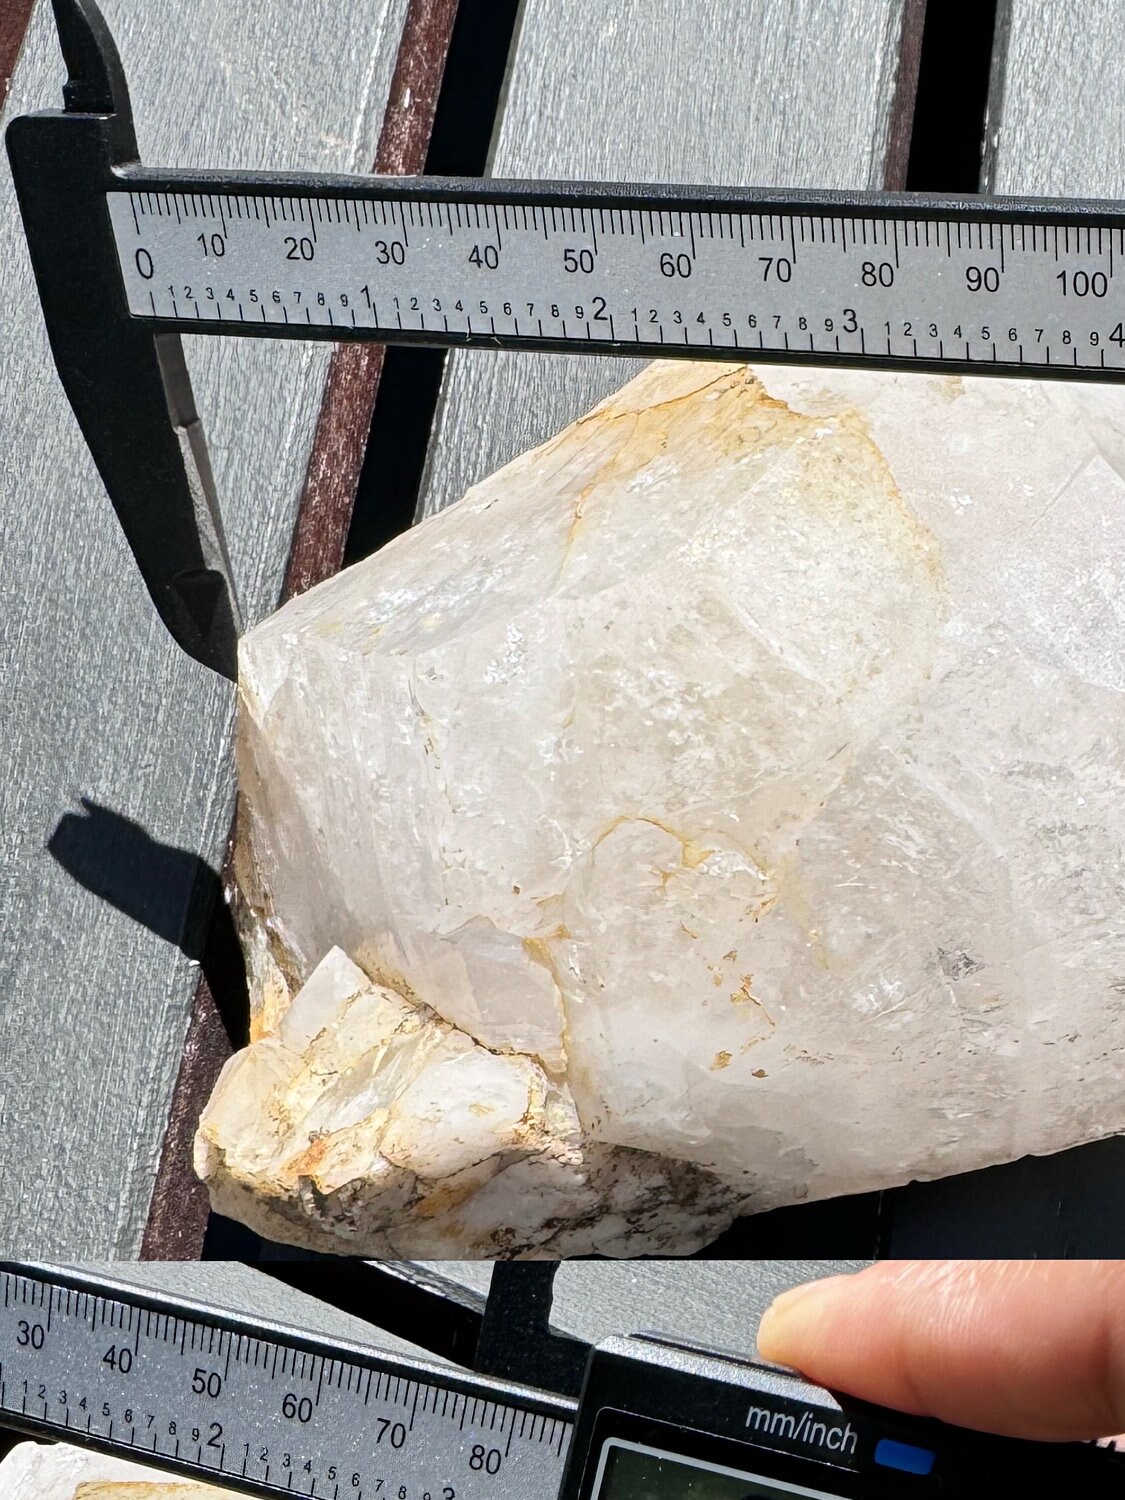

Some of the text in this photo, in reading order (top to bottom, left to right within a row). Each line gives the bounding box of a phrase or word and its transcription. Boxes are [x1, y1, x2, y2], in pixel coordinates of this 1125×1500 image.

[135, 248, 154, 280] 0
[197, 233, 225, 257] 10
[284, 237, 315, 261] 20
[375, 240, 405, 265] 30
[468, 245, 499, 270] 40
[564, 248, 594, 274] 50
[660, 252, 692, 278] 60
[758, 257, 792, 283] 70
[861, 261, 894, 287] 80
[966, 266, 1000, 293] 90
[1056, 270, 1108, 298] 100
[168, 285, 175, 298] 1
[184, 286, 194, 300] 2
[205, 287, 215, 300] 3
[226, 288, 235, 301] 4
[249, 289, 258, 303] 5
[272, 290, 281, 304] 6
[293, 291, 302, 304] 7
[317, 292, 326, 306] 8
[339, 293, 348, 307] 9
[360, 284, 372, 309] 1
[393, 297, 400, 310] 1
[410, 297, 420, 311] 2
[432, 298, 442, 312] 3
[455, 300, 464, 312] 4
[479, 300, 488, 314] 5
[503, 302, 512, 316] 6
[526, 303, 534, 317] 7
[551, 304, 560, 318] 8
[575, 305, 584, 319] 9
[592, 296, 608, 321] 2
[631, 307, 637, 322] 1
[649, 309, 659, 323] 2
[673, 310, 683, 324] 3
[696, 311, 706, 325] 4
[722, 312, 732, 327] 5
[748, 314, 757, 329] 6
[772, 315, 781, 330] 7
[798, 316, 808, 331] 8
[824, 318, 834, 332] 9
[843, 308, 858, 333] 3
[884, 321, 890, 336] 1
[903, 322, 913, 336] 2
[929, 323, 938, 338] 3
[953, 325, 962, 339] 4
[981, 326, 990, 341] 5
[1008, 328, 1018, 342] 6
[1034, 328, 1044, 343] 7
[1062, 330, 1071, 345] 8
[1090, 331, 1099, 346] 9
[1109, 322, 1125, 348] 4
[16, 1320, 501, 1475] 30 40 50 60 70 80
[745, 1404, 858, 1454] mm/inch
[23, 1379, 28, 1394] 1
[37, 1384, 46, 1400] 2
[58, 1390, 67, 1405] 3
[79, 1396, 87, 1411] 4
[102, 1402, 111, 1417] 5
[124, 1408, 133, 1424] 6
[147, 1414, 155, 1429] 7
[168, 1421, 177, 1435] 8
[192, 1428, 200, 1442] 9
[206, 1422, 223, 1448] 2
[243, 1443, 250, 1457] 1
[260, 1446, 269, 1463] 2
[282, 1453, 291, 1468] 3
[303, 1460, 312, 1474] 4
[328, 1466, 337, 1481] 5
[351, 1472, 360, 1487] 6
[375, 1478, 384, 1493] 7
[398, 1485, 407, 1500] 8
